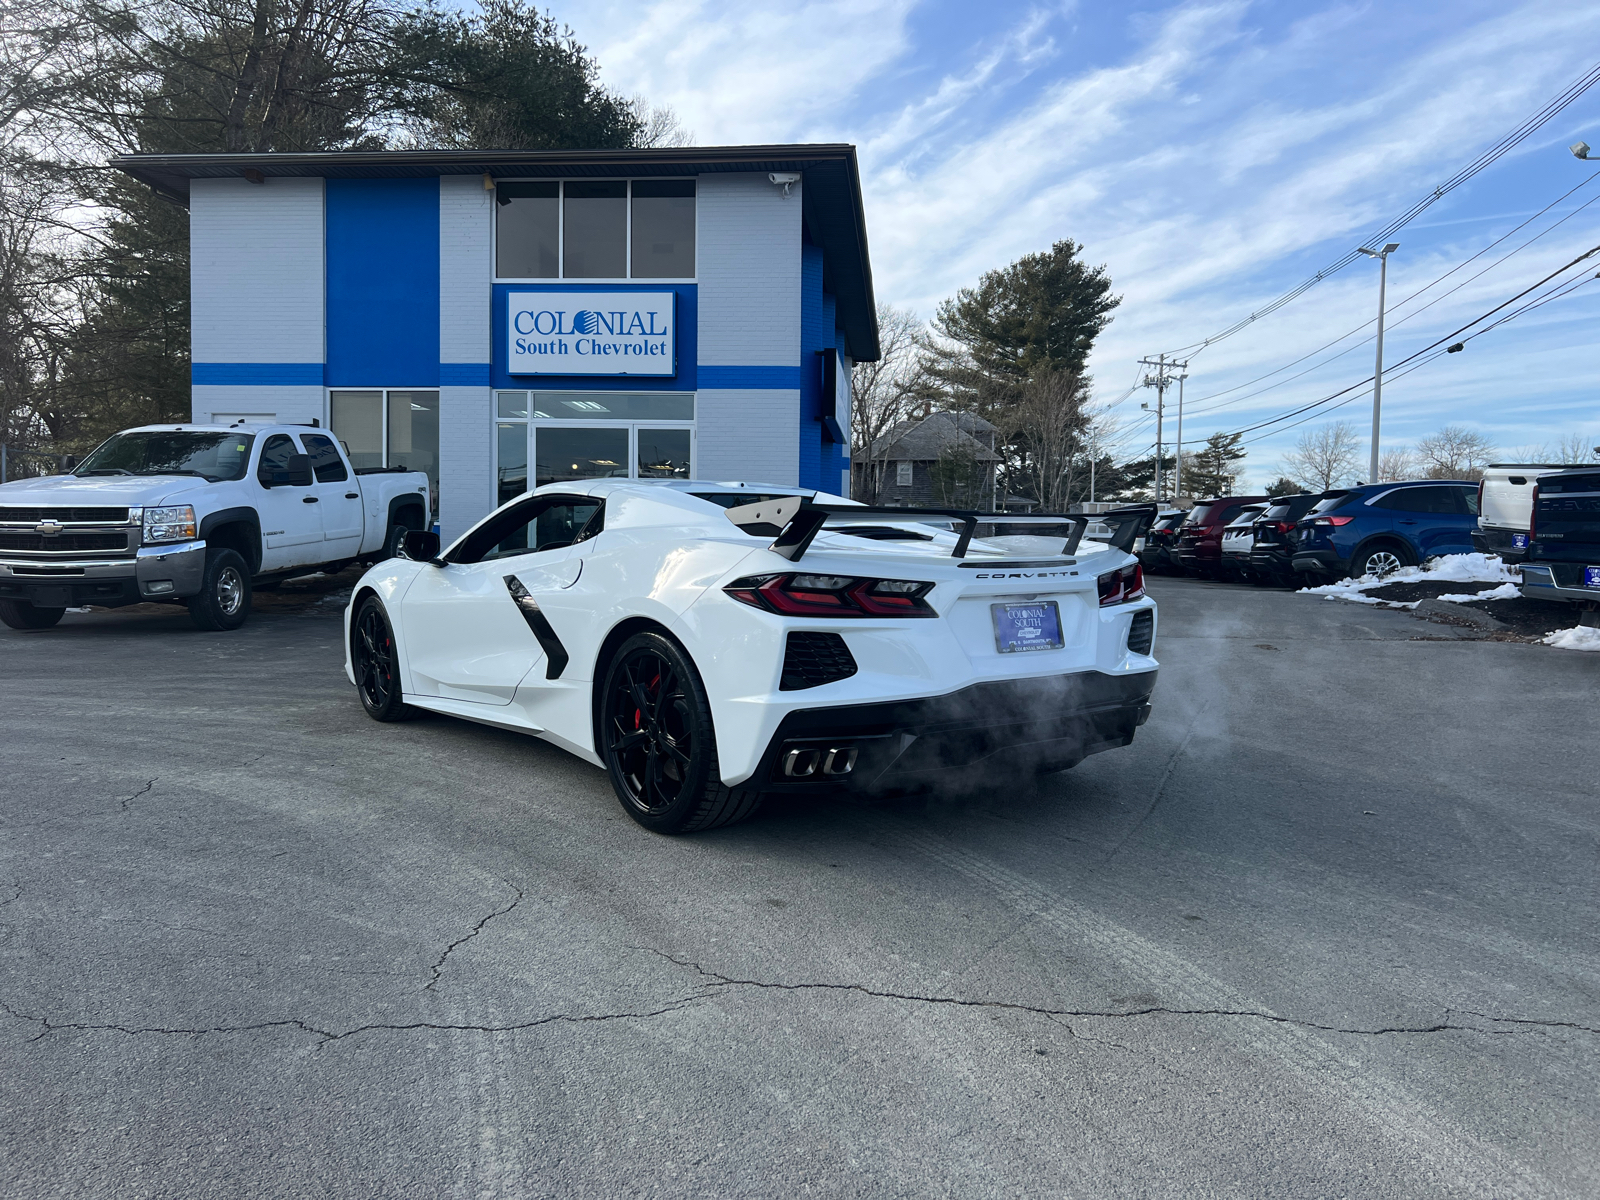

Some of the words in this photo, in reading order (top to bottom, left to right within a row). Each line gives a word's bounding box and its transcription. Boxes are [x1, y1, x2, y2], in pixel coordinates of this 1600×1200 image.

[514, 310, 667, 335] COLONIAL
[515, 338, 568, 355] South
[575, 338, 667, 356] Chevrolet
[975, 571, 1079, 579] CORVETTE
[1007, 609, 1045, 619] COLONIAL
[1014, 617, 1042, 627] SOUTH
